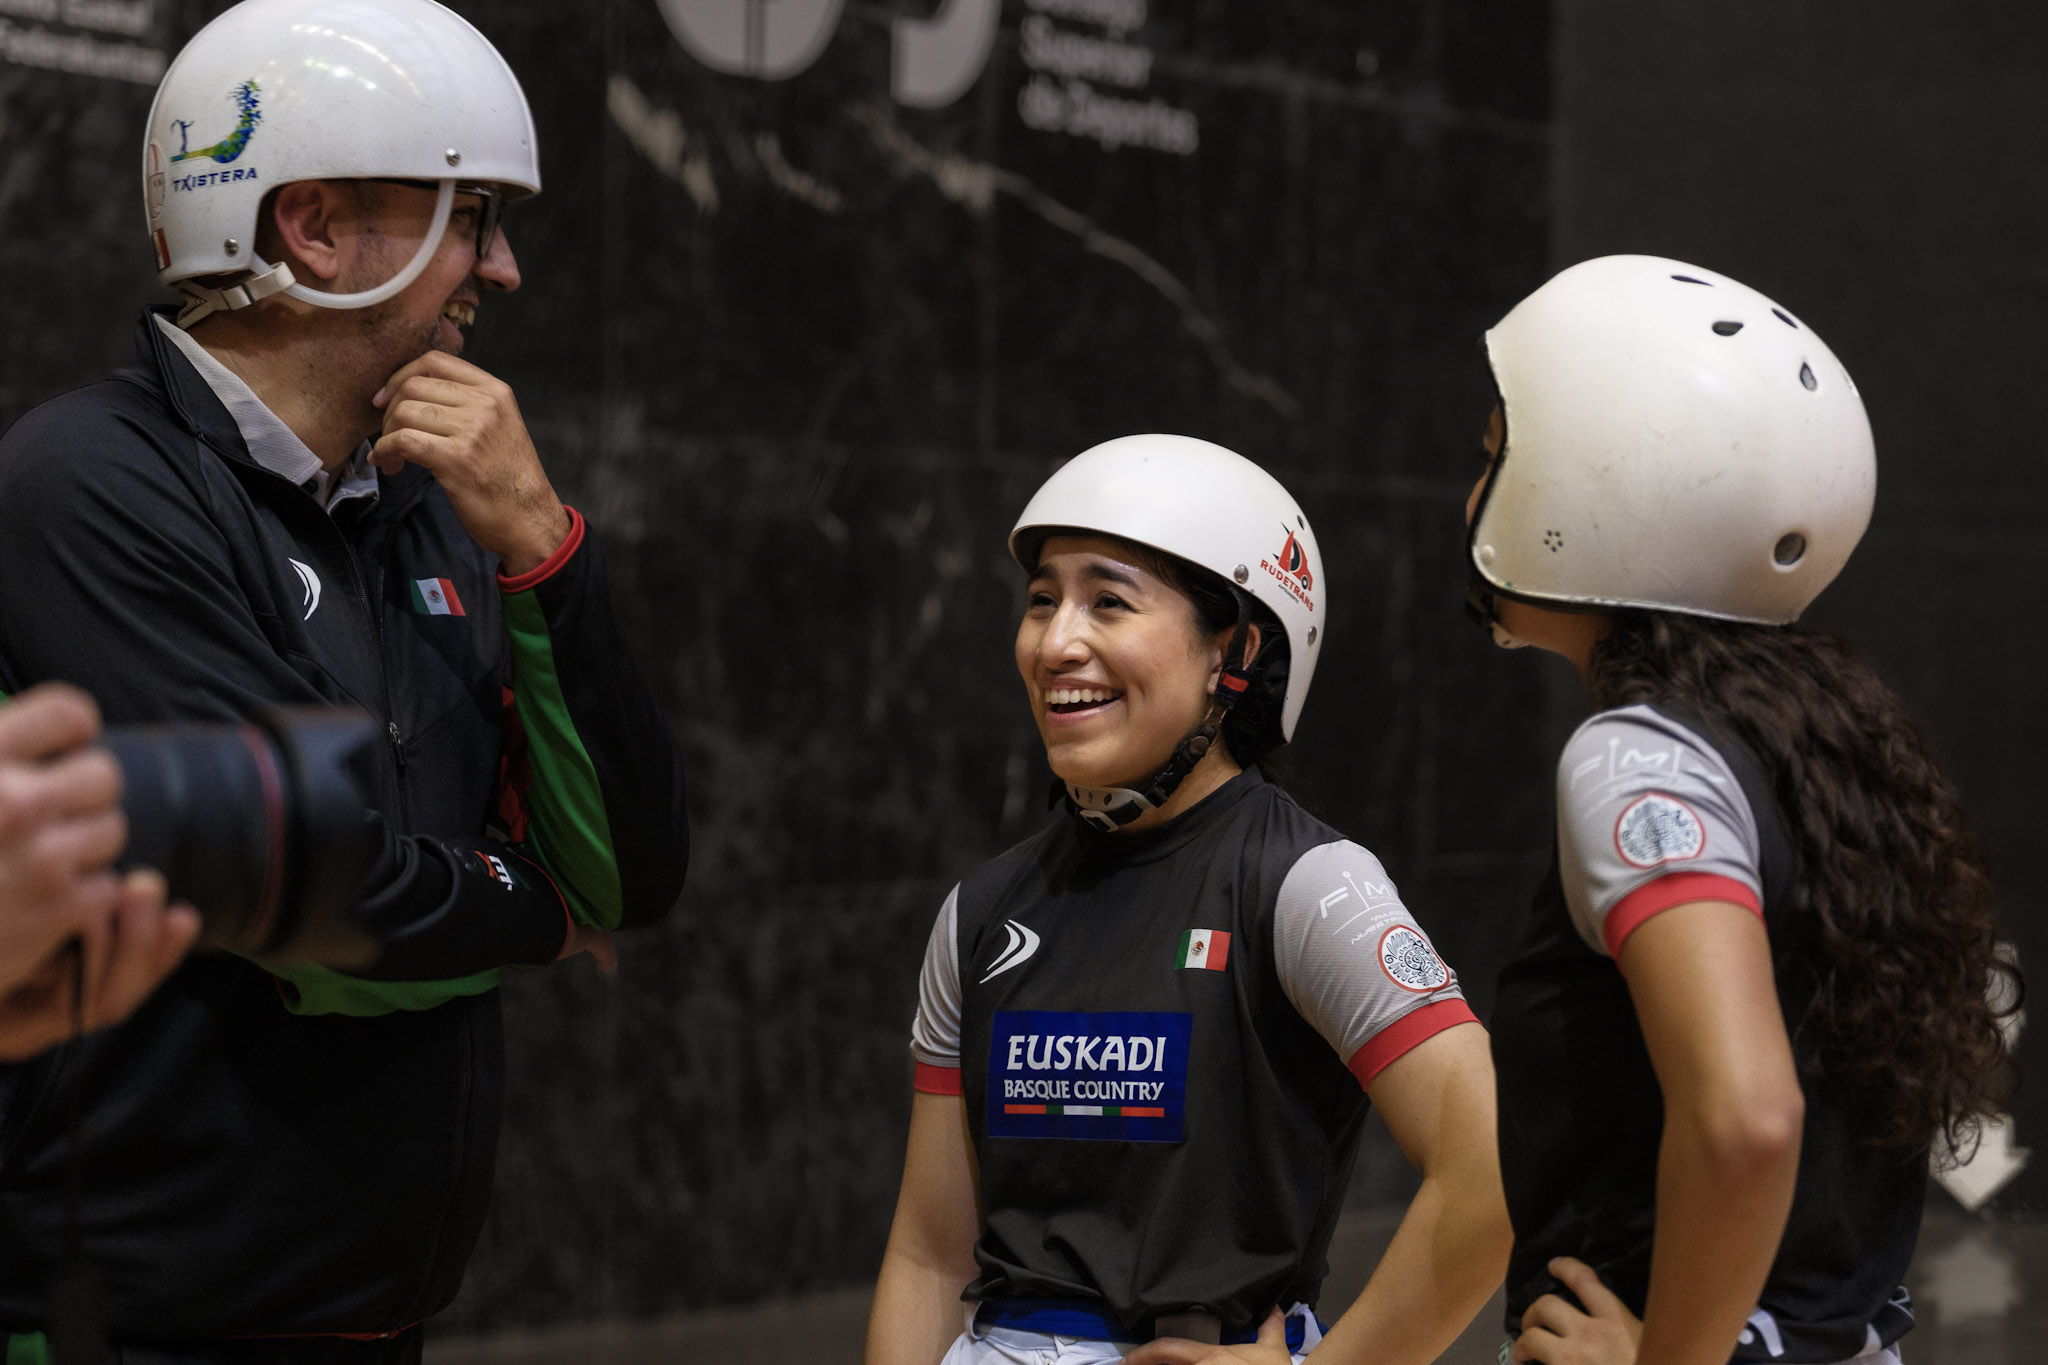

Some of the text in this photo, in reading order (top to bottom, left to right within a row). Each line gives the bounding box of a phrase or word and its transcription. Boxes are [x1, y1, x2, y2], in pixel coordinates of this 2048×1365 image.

[173, 167, 258, 192] TXISTERA
[1260, 559, 1314, 612] RUDETRANS
[1006, 1034, 1167, 1072] EUSKADI
[1004, 1079, 1165, 1101] BASQUE COUNTRY
